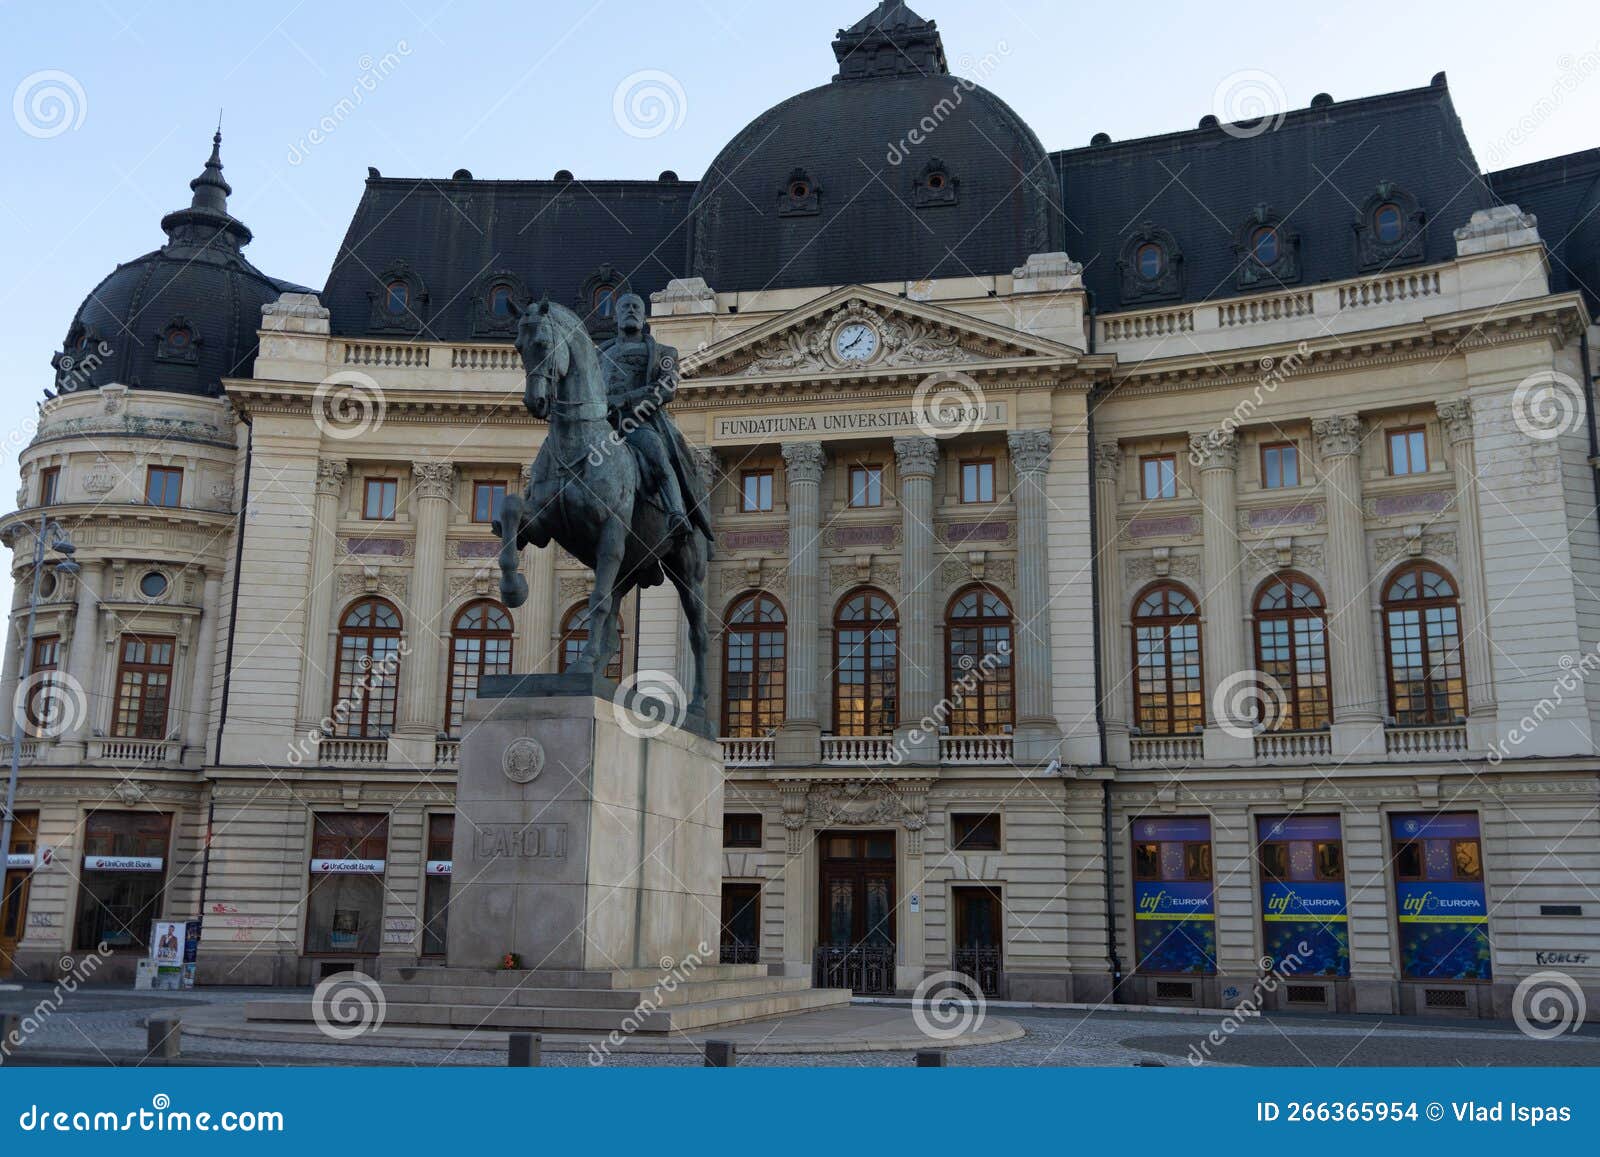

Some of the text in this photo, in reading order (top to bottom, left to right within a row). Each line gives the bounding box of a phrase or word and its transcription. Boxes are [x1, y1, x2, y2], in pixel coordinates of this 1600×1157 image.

[720, 405, 1001, 435] FUNDATIUNEA UNIVERSITARA CAROL I
[105, 860, 152, 868] UniCredit Bank
[330, 862, 376, 871] UniCredit Bank
[1173, 897, 1209, 906] EUROPA
[1303, 899, 1341, 907] EUROPA
[1440, 899, 1481, 907] EUROPA
